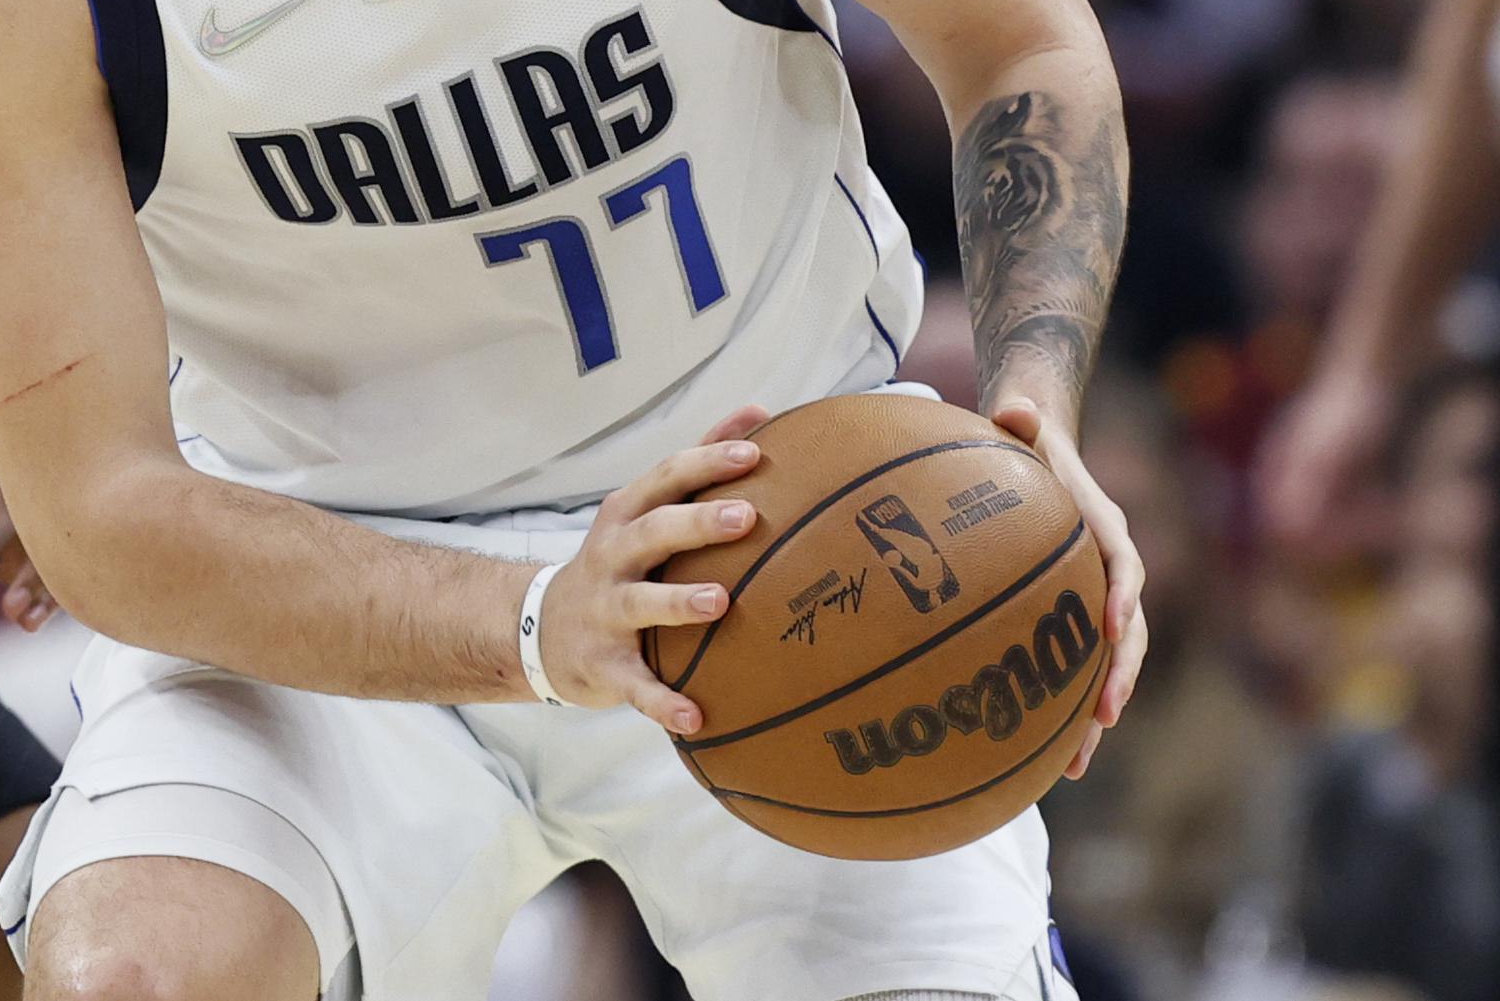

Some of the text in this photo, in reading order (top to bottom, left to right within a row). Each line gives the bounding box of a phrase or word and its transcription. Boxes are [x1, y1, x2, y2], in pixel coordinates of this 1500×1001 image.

[228, 3, 678, 227] DALLAS
[473, 151, 731, 377] 77
[871, 499, 904, 525] NBA
[824, 589, 1099, 776] Wilson
